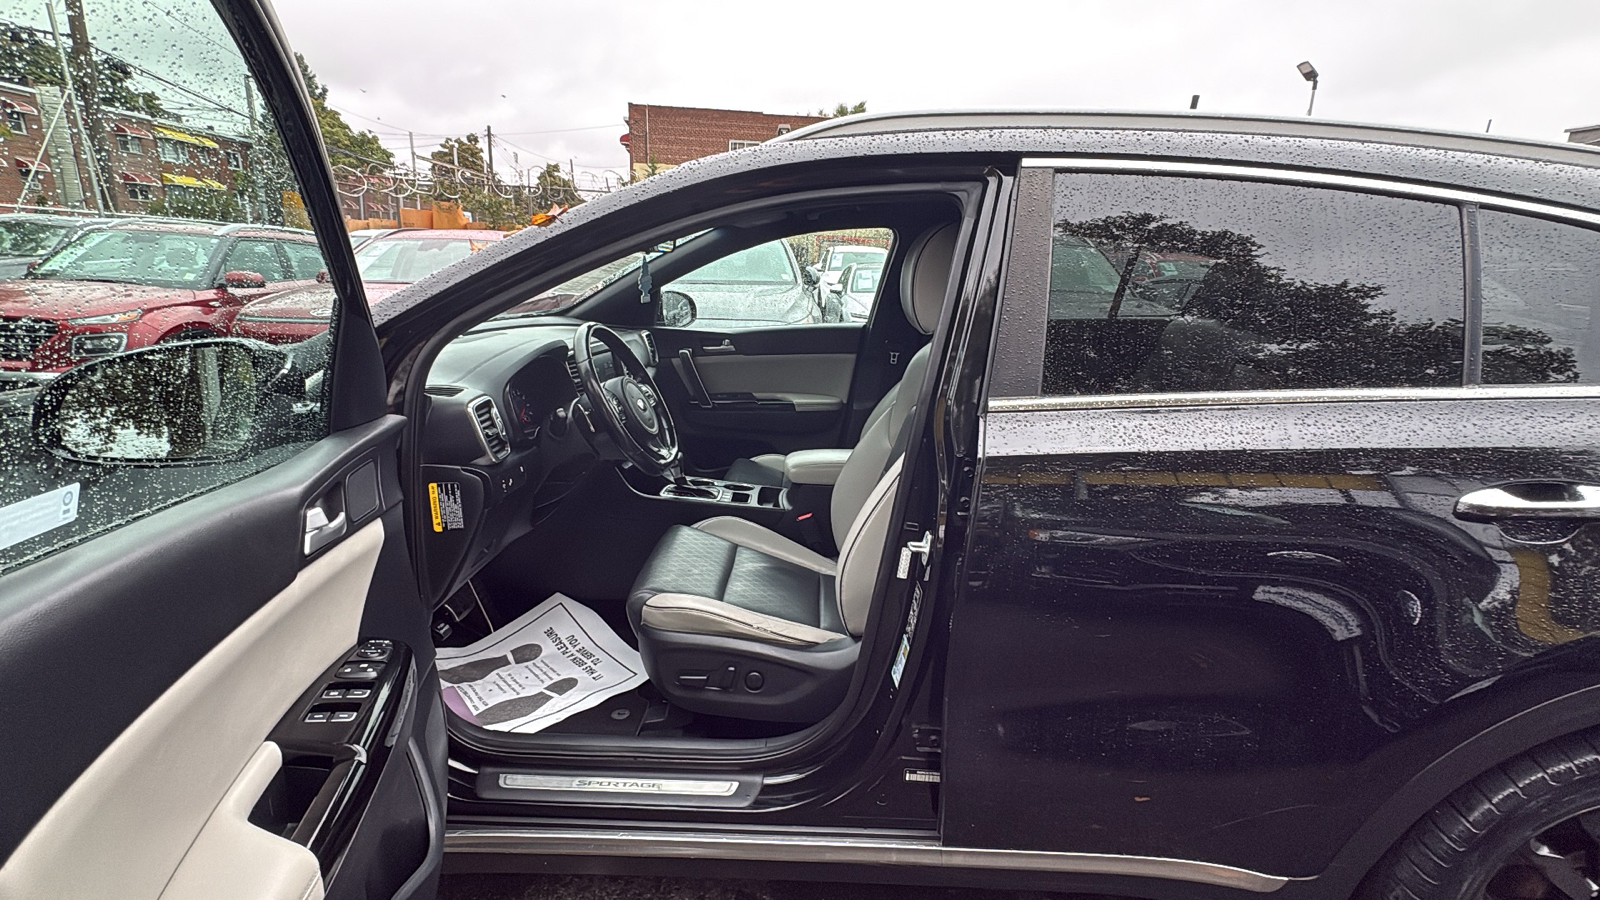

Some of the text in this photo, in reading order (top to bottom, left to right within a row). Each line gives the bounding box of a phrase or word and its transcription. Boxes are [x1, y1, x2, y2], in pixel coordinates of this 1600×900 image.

[543, 626, 571, 656] PLEASURE
[565, 634, 602, 666] TO SERVE YOU
[570, 656, 588, 668] BEEN
[582, 665, 598, 676] HAS
